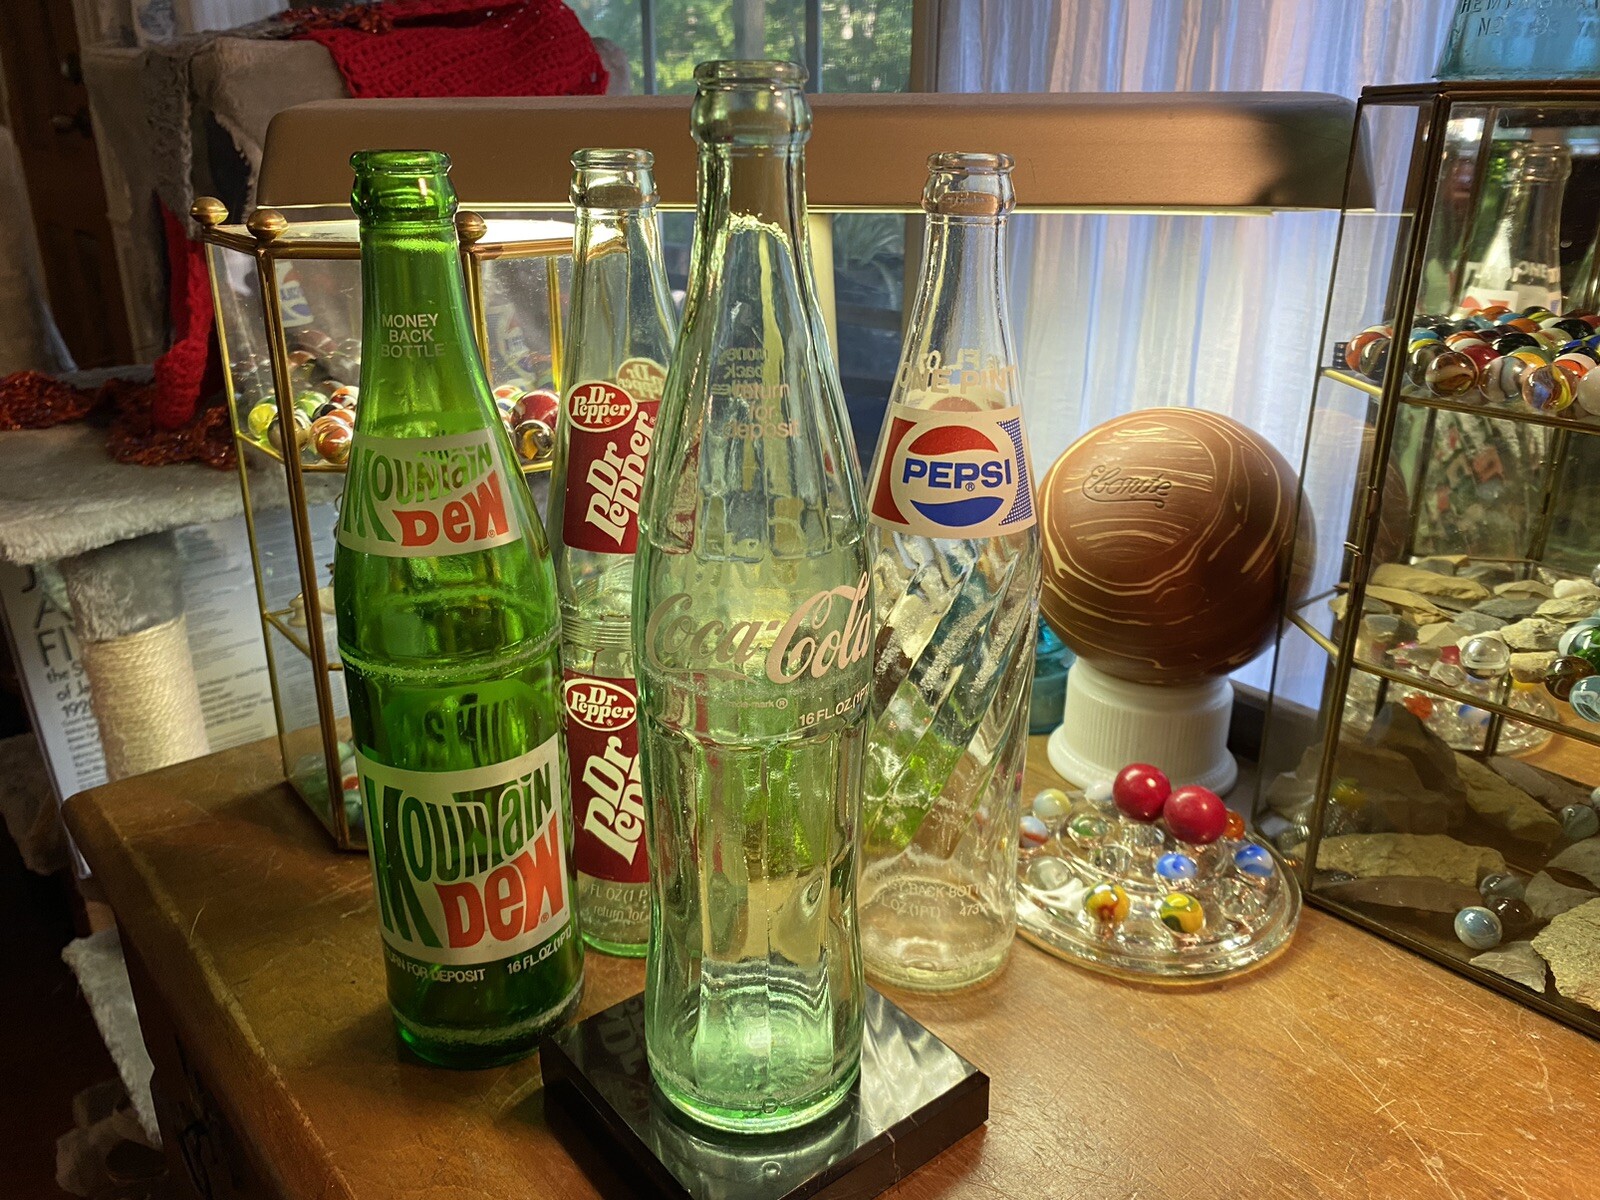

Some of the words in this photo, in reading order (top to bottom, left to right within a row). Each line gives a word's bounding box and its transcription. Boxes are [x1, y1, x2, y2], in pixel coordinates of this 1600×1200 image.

[382, 313, 438, 328] MONEY
[389, 329, 434, 343] BACK
[381, 343, 446, 358] BOTTLE
[898, 361, 952, 393] ONE
[960, 364, 1018, 394] PINT
[587, 385, 617, 406] Dr
[571, 395, 631, 424] Pepper
[722, 419, 800, 440] deposit
[586, 441, 625, 501] Dr
[902, 457, 1012, 489] PEPSI
[646, 571, 872, 685] Coca-Cola
[570, 691, 635, 724] Pepper
[586, 686, 618, 707] Dr
[799, 712, 815, 726] 16
[582, 735, 633, 811] Dr
[407, 962, 429, 979] FOR
[432, 968, 486, 982] DEPOSIT
[507, 960, 522, 976] 16
